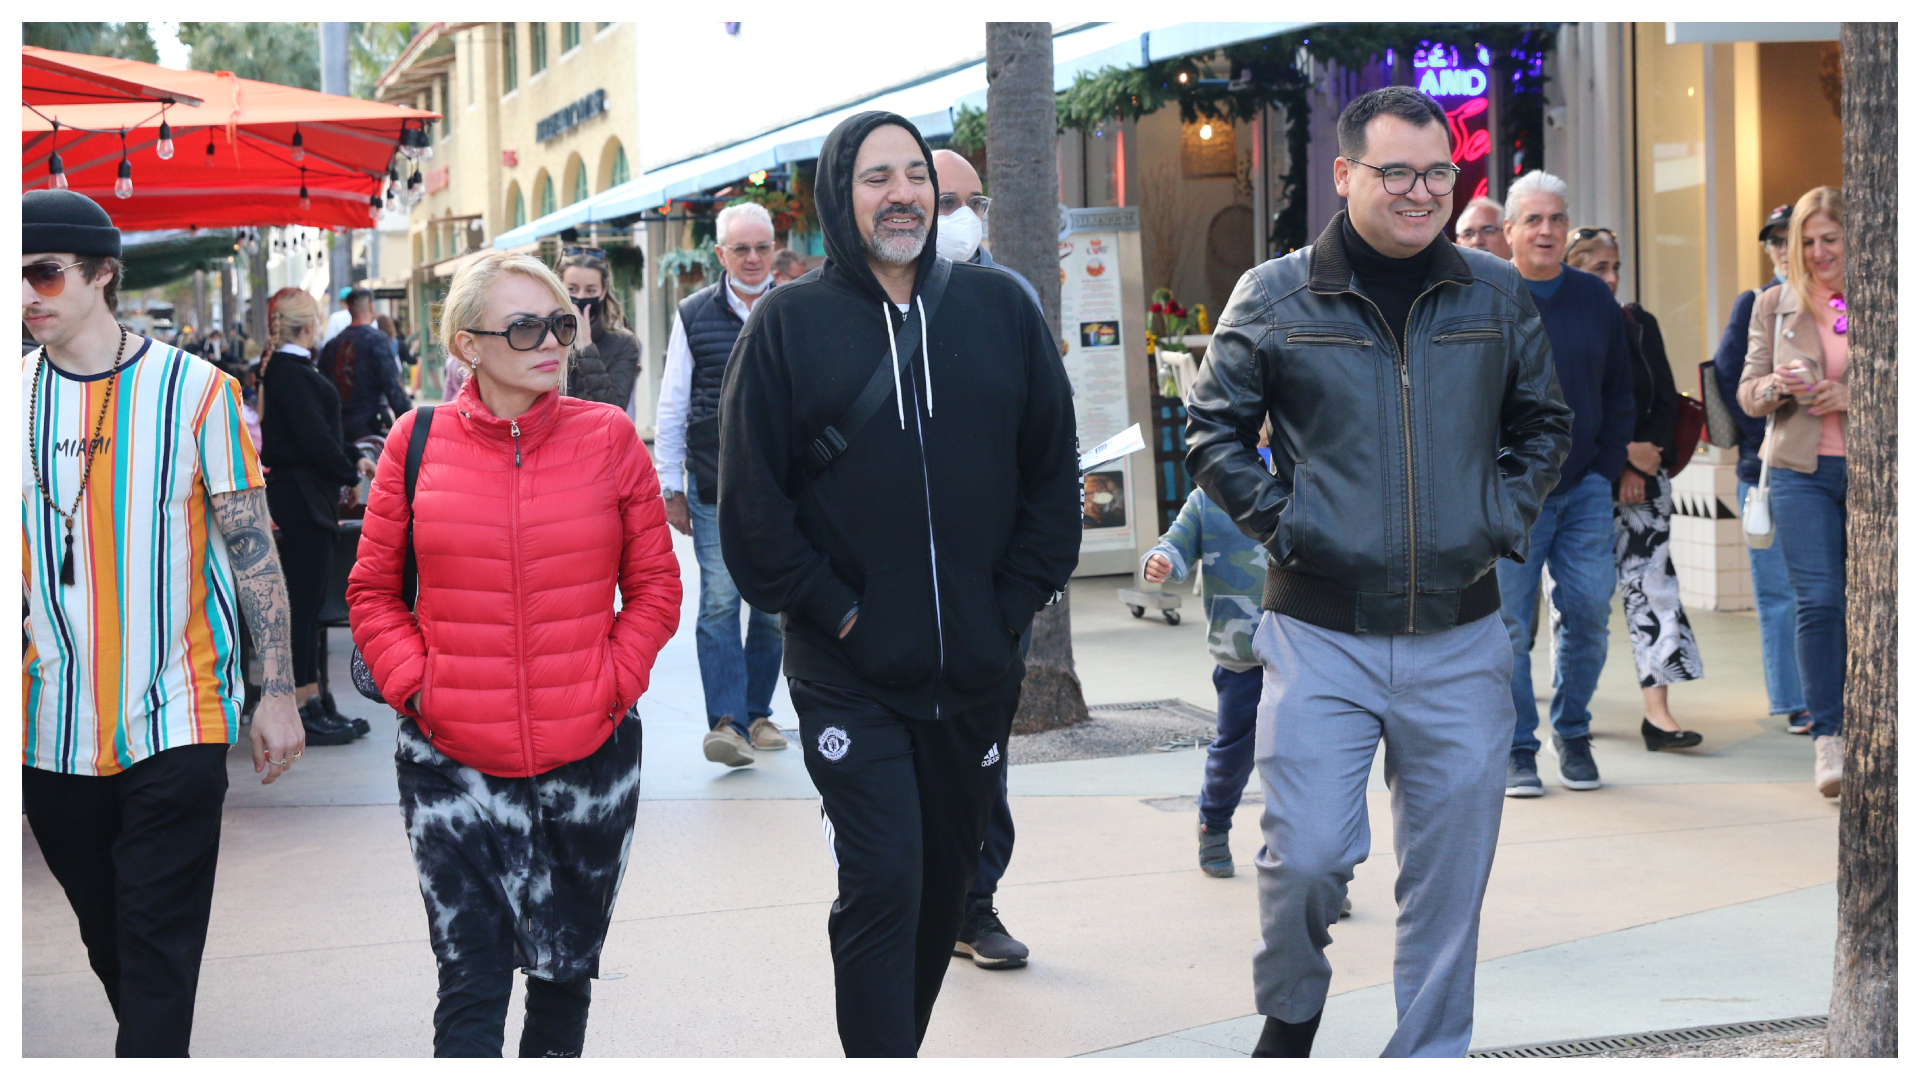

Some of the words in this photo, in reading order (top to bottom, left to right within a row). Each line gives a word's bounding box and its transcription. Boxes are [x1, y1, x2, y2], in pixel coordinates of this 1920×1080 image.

[1418, 68, 1487, 96] AND
[53, 435, 112, 458] MIAMI
[981, 754, 1000, 767] adidas
